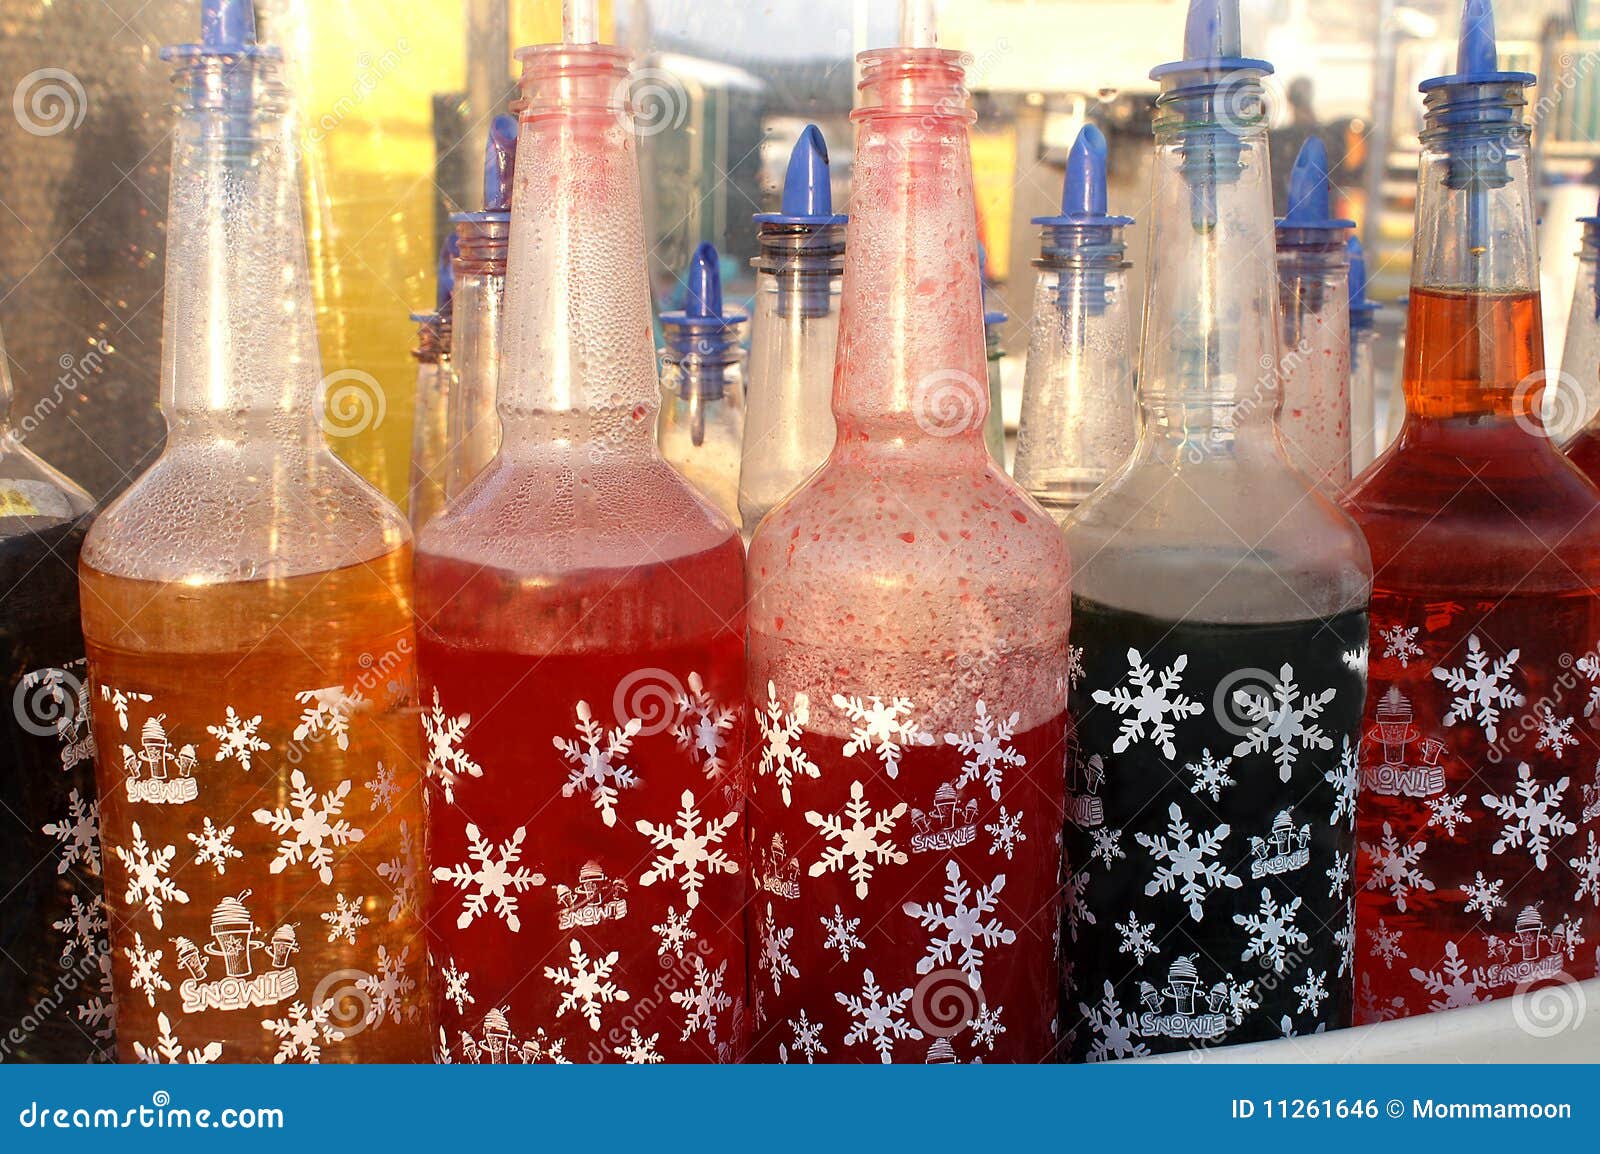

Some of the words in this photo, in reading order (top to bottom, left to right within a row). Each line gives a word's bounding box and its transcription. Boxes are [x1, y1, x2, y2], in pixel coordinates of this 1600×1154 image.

[126, 777, 198, 804] SNOWIE
[1359, 763, 1446, 798] NOWIE
[911, 823, 976, 853] SNOWIE
[1251, 847, 1310, 879] SNOWIE
[1487, 953, 1564, 988] SNOWIE
[180, 967, 299, 1013] SNOWIE
[1141, 1012, 1227, 1038] SNOWIE
